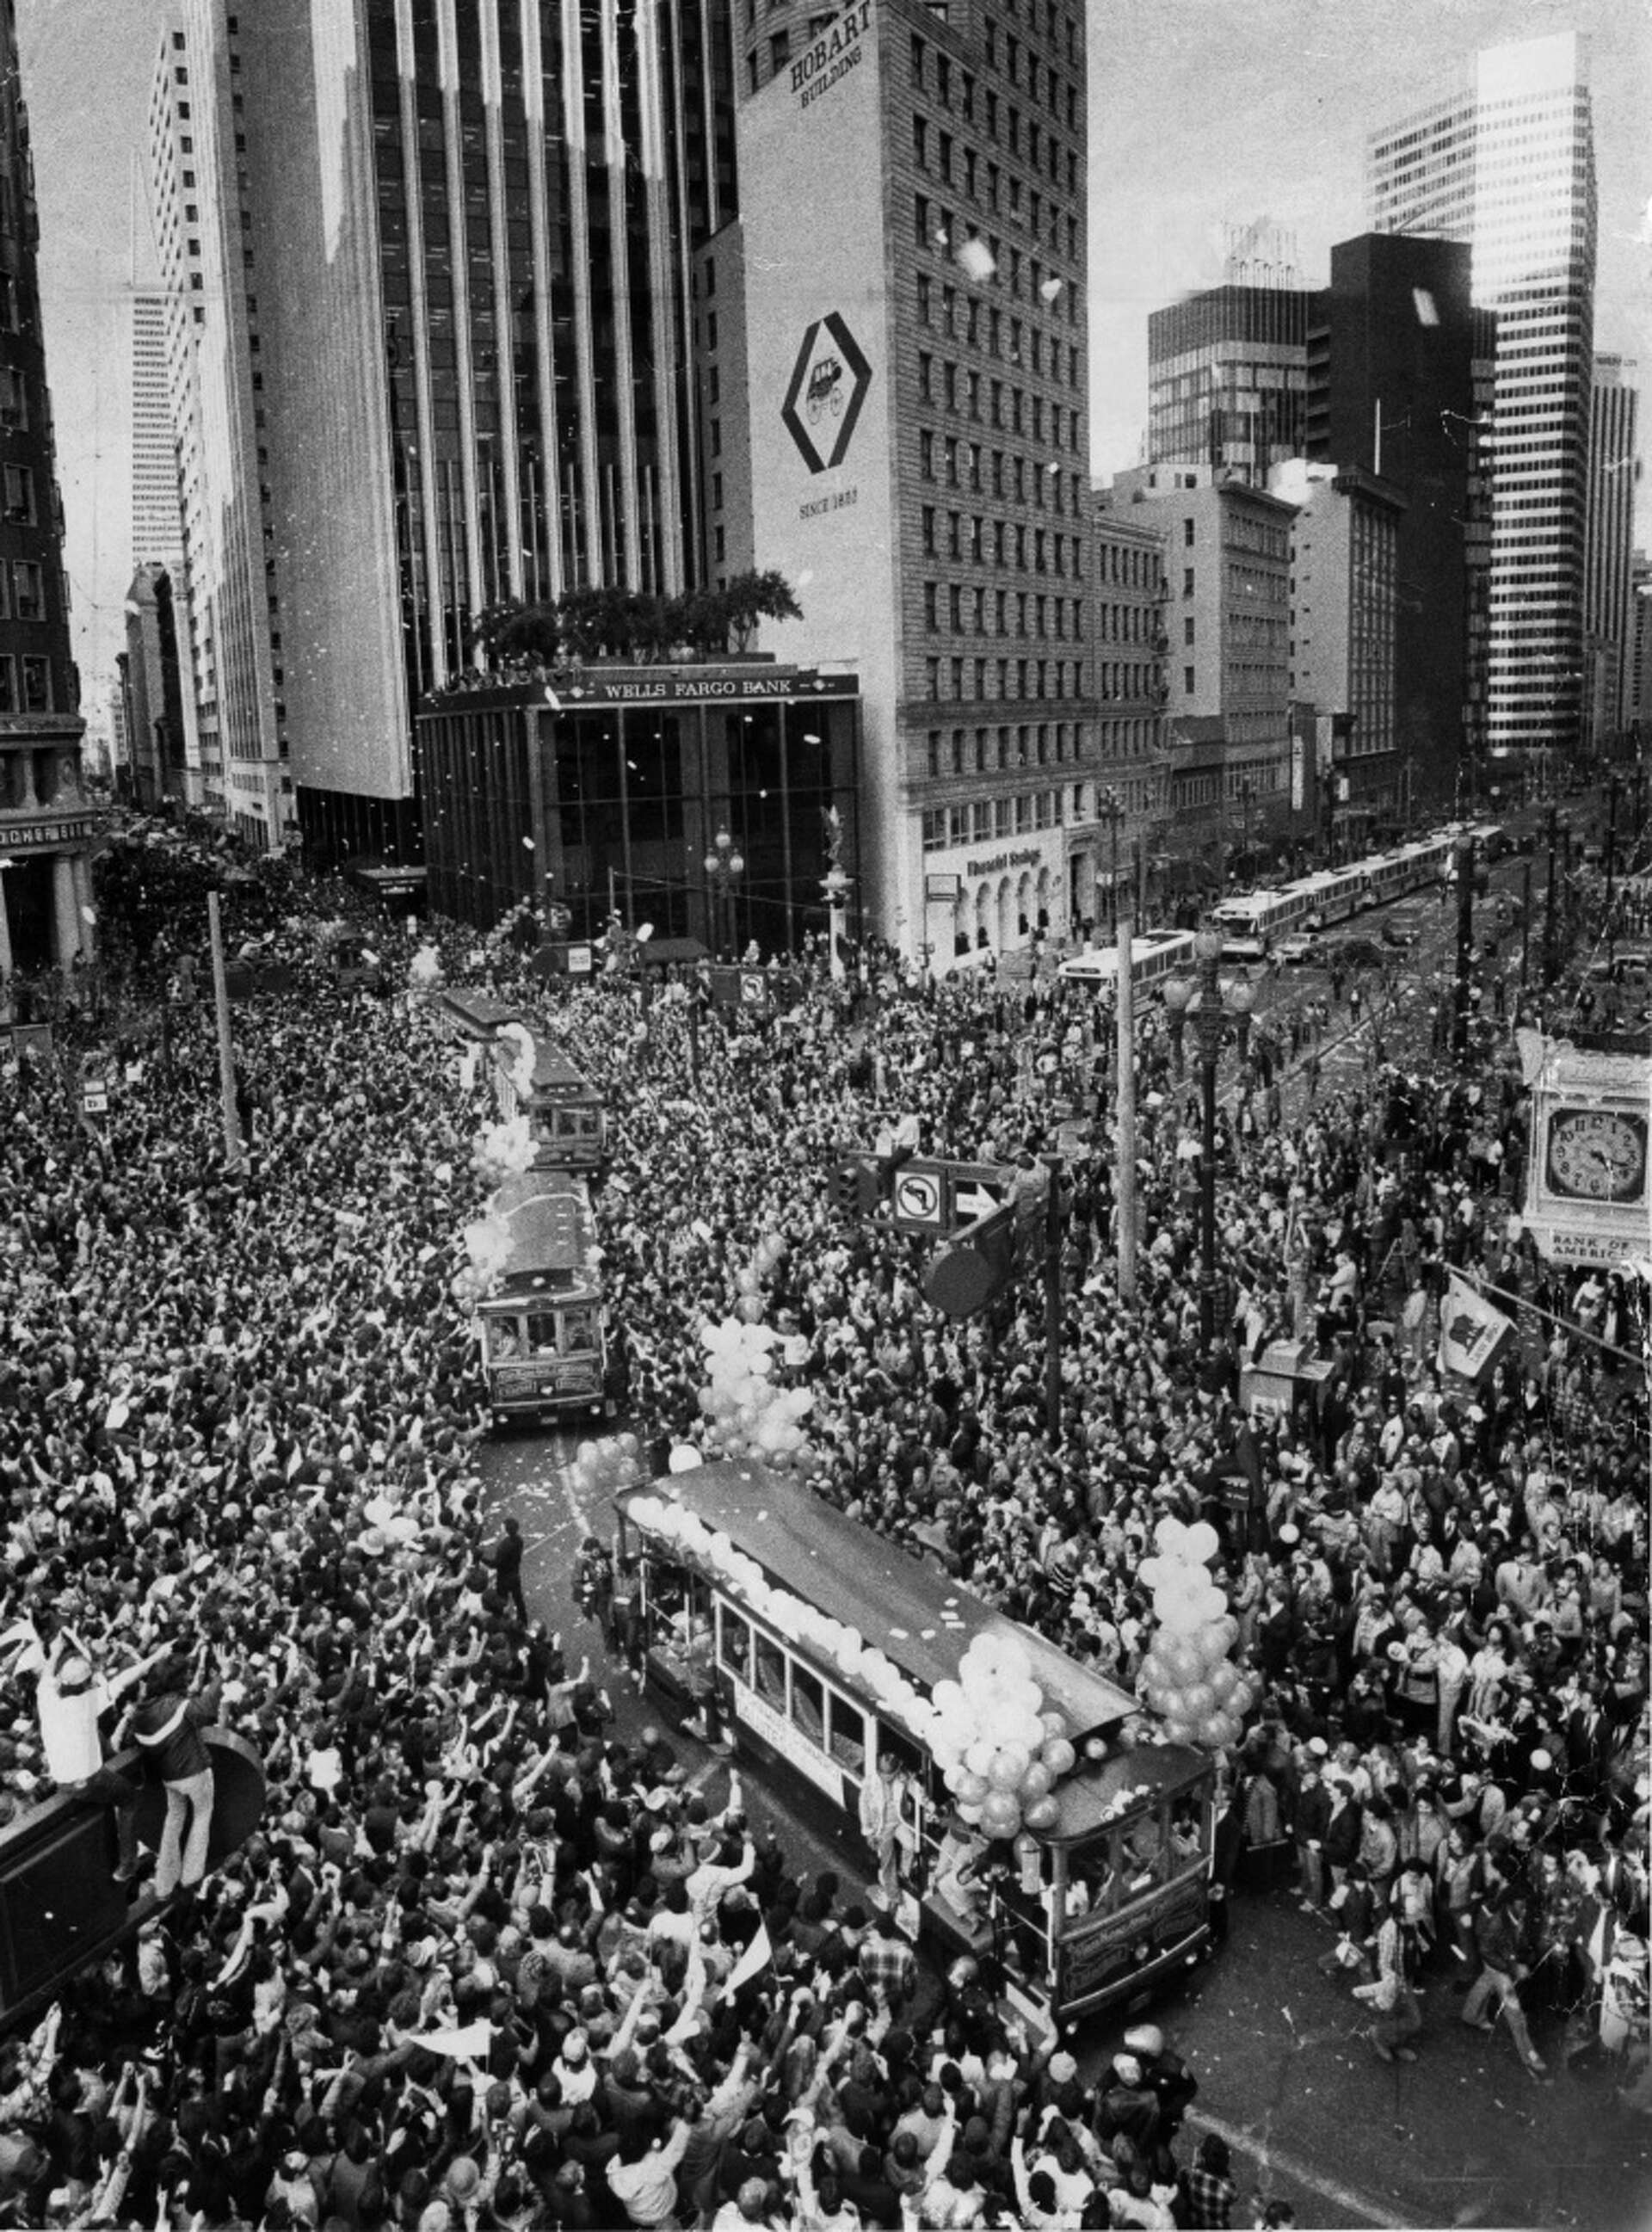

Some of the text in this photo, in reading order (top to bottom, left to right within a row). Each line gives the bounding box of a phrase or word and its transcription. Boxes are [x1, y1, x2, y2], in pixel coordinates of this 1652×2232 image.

[790, 0, 871, 94] HOBART
[801, 45, 862, 108] BUILDING
[798, 498, 829, 520] SINCE
[605, 679, 792, 698] WELLS FARGO BANK
[1623, 1133, 1631, 1147] 2
[1556, 1145, 1565, 1158] 9
[1560, 1162, 1570, 1175] 8
[1553, 1235, 1630, 1250] BANK OF
